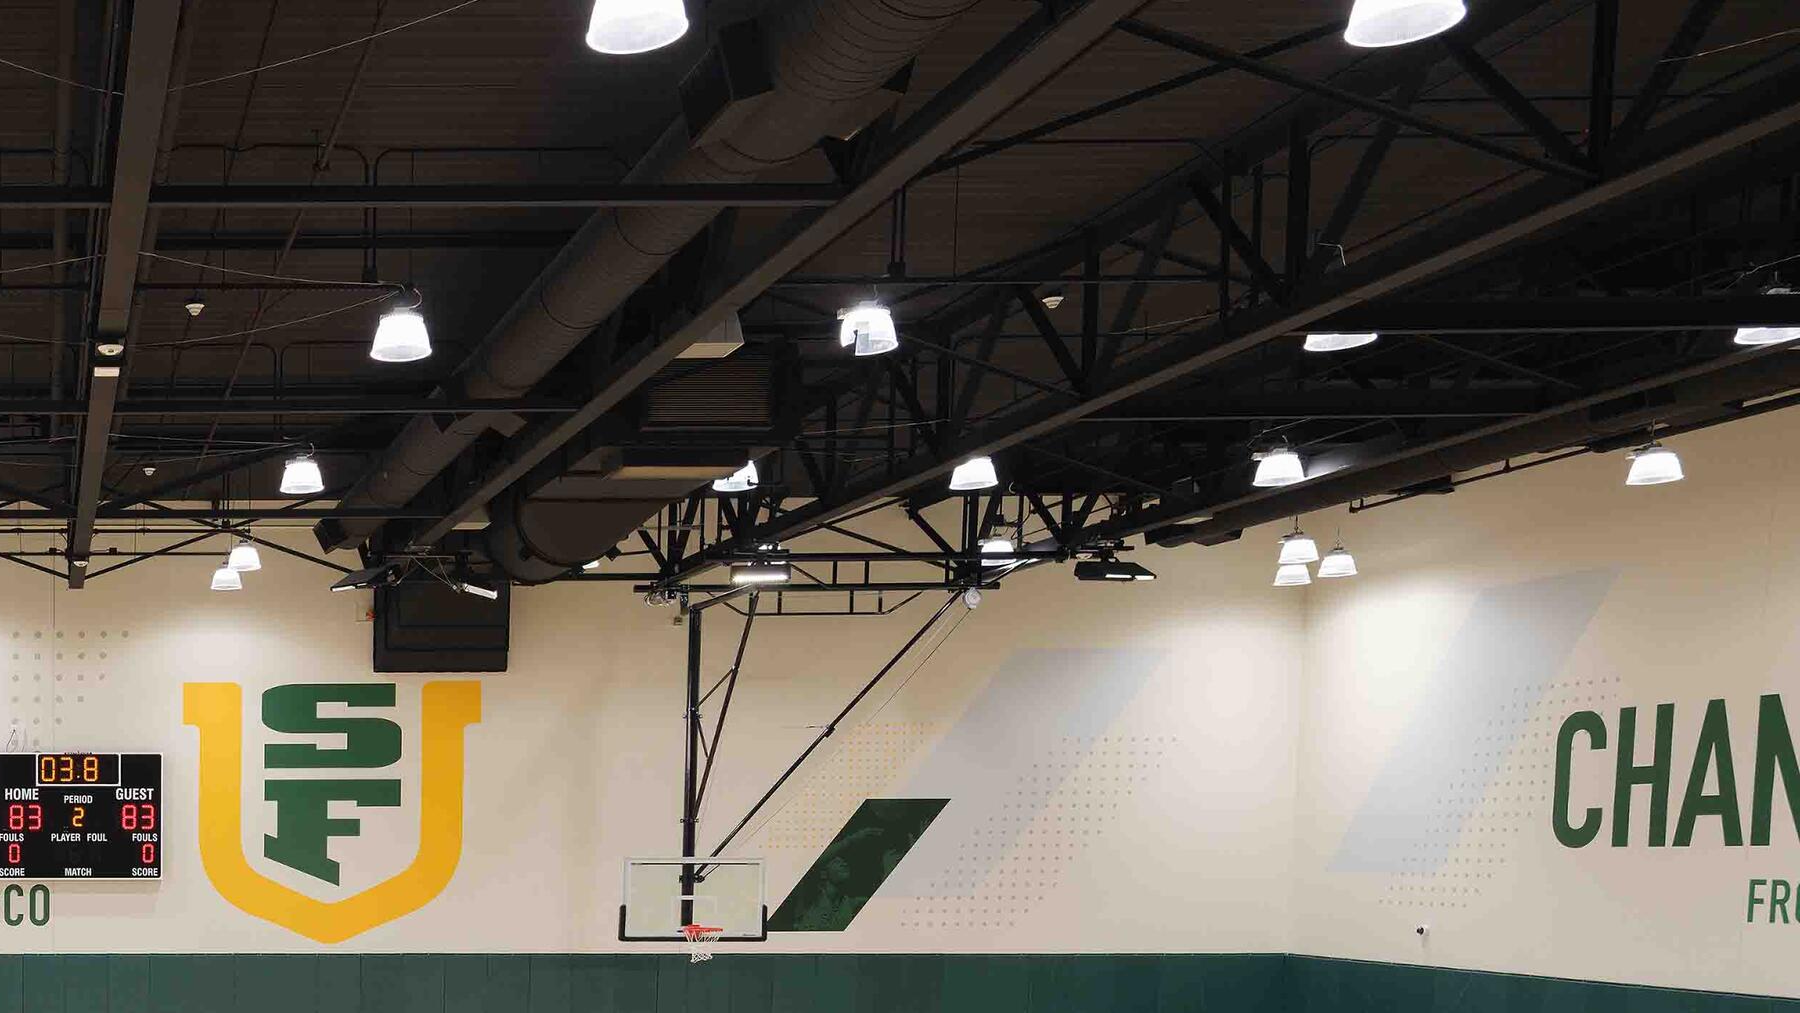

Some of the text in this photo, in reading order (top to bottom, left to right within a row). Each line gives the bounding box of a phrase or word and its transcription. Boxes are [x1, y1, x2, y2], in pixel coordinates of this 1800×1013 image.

[4, 788, 40, 801] HOME
[63, 795, 93, 804] PERIOD
[115, 788, 155, 801] GUEST
[9, 804, 42, 830] 83
[72, 806, 85, 827] 2
[121, 804, 155, 830] 83
[50, 833, 108, 842] PLAYER FOUL
[131, 833, 158, 842] FOULS
[8, 843, 21, 864] 0
[142, 843, 155, 864] 0
[64, 867, 92, 877] MATCH
[131, 867, 159, 877] SCORE
[1747, 879, 1800, 924] FR
